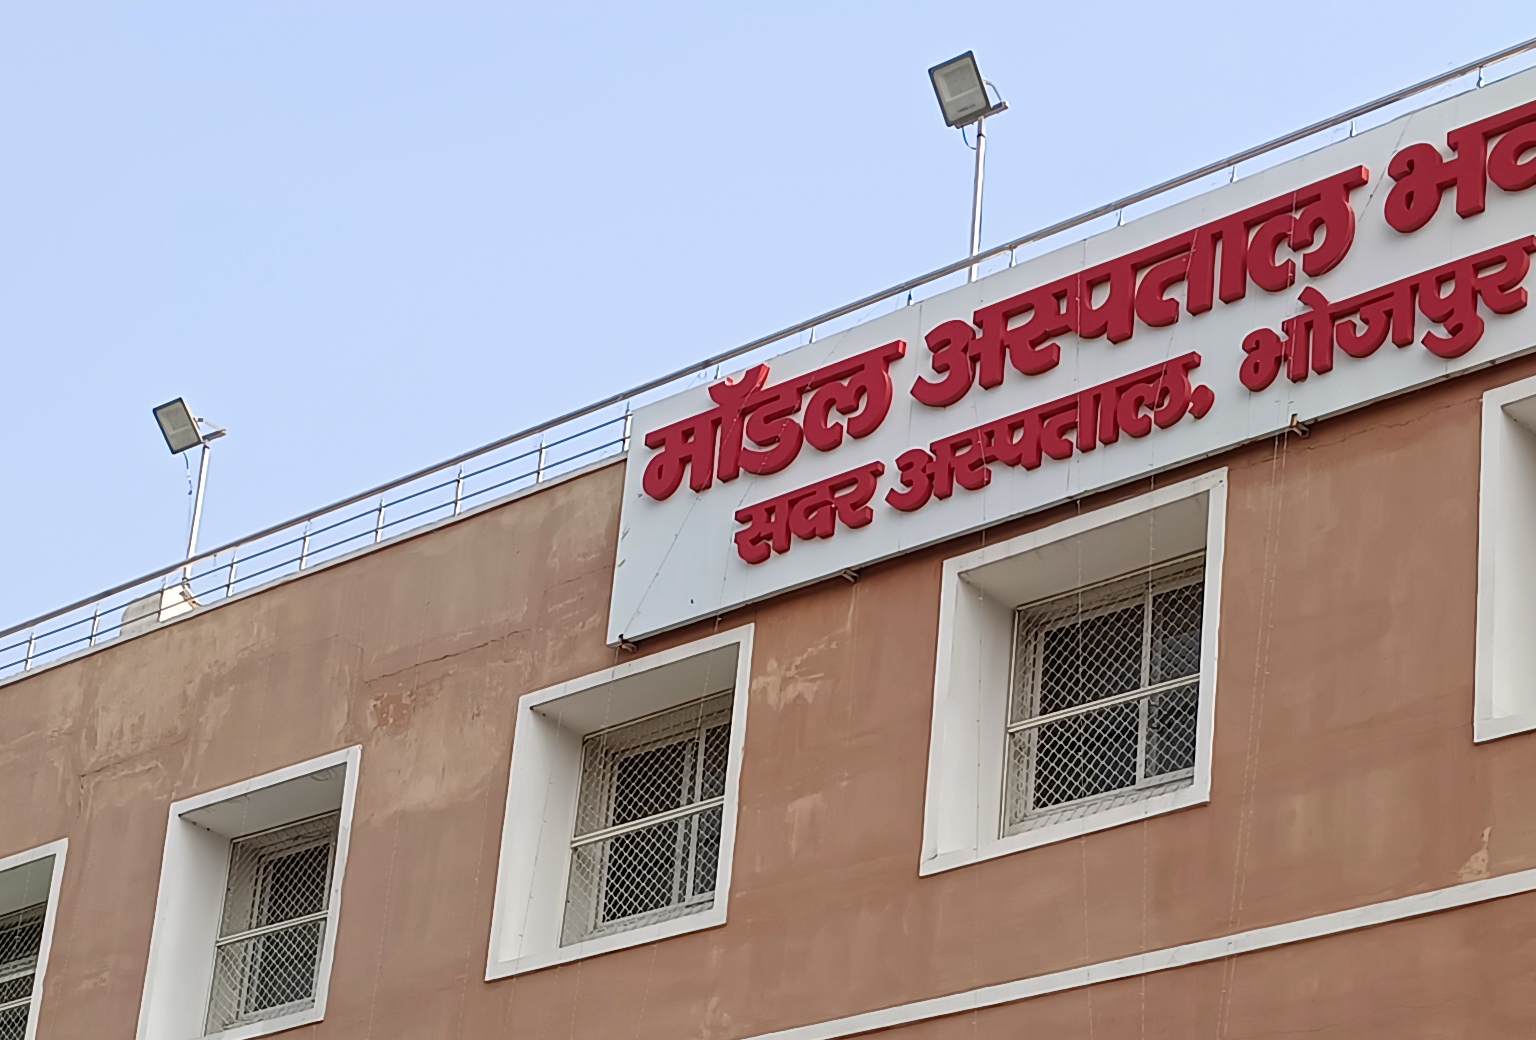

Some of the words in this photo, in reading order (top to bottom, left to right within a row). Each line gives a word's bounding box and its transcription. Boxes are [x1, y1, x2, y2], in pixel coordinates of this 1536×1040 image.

[643, 338, 906, 500] मॉडल
[911, 164, 1370, 409] अस्पताल
[734, 460, 885, 564] सदर
[886, 351, 1215, 512] अस्पताल,
